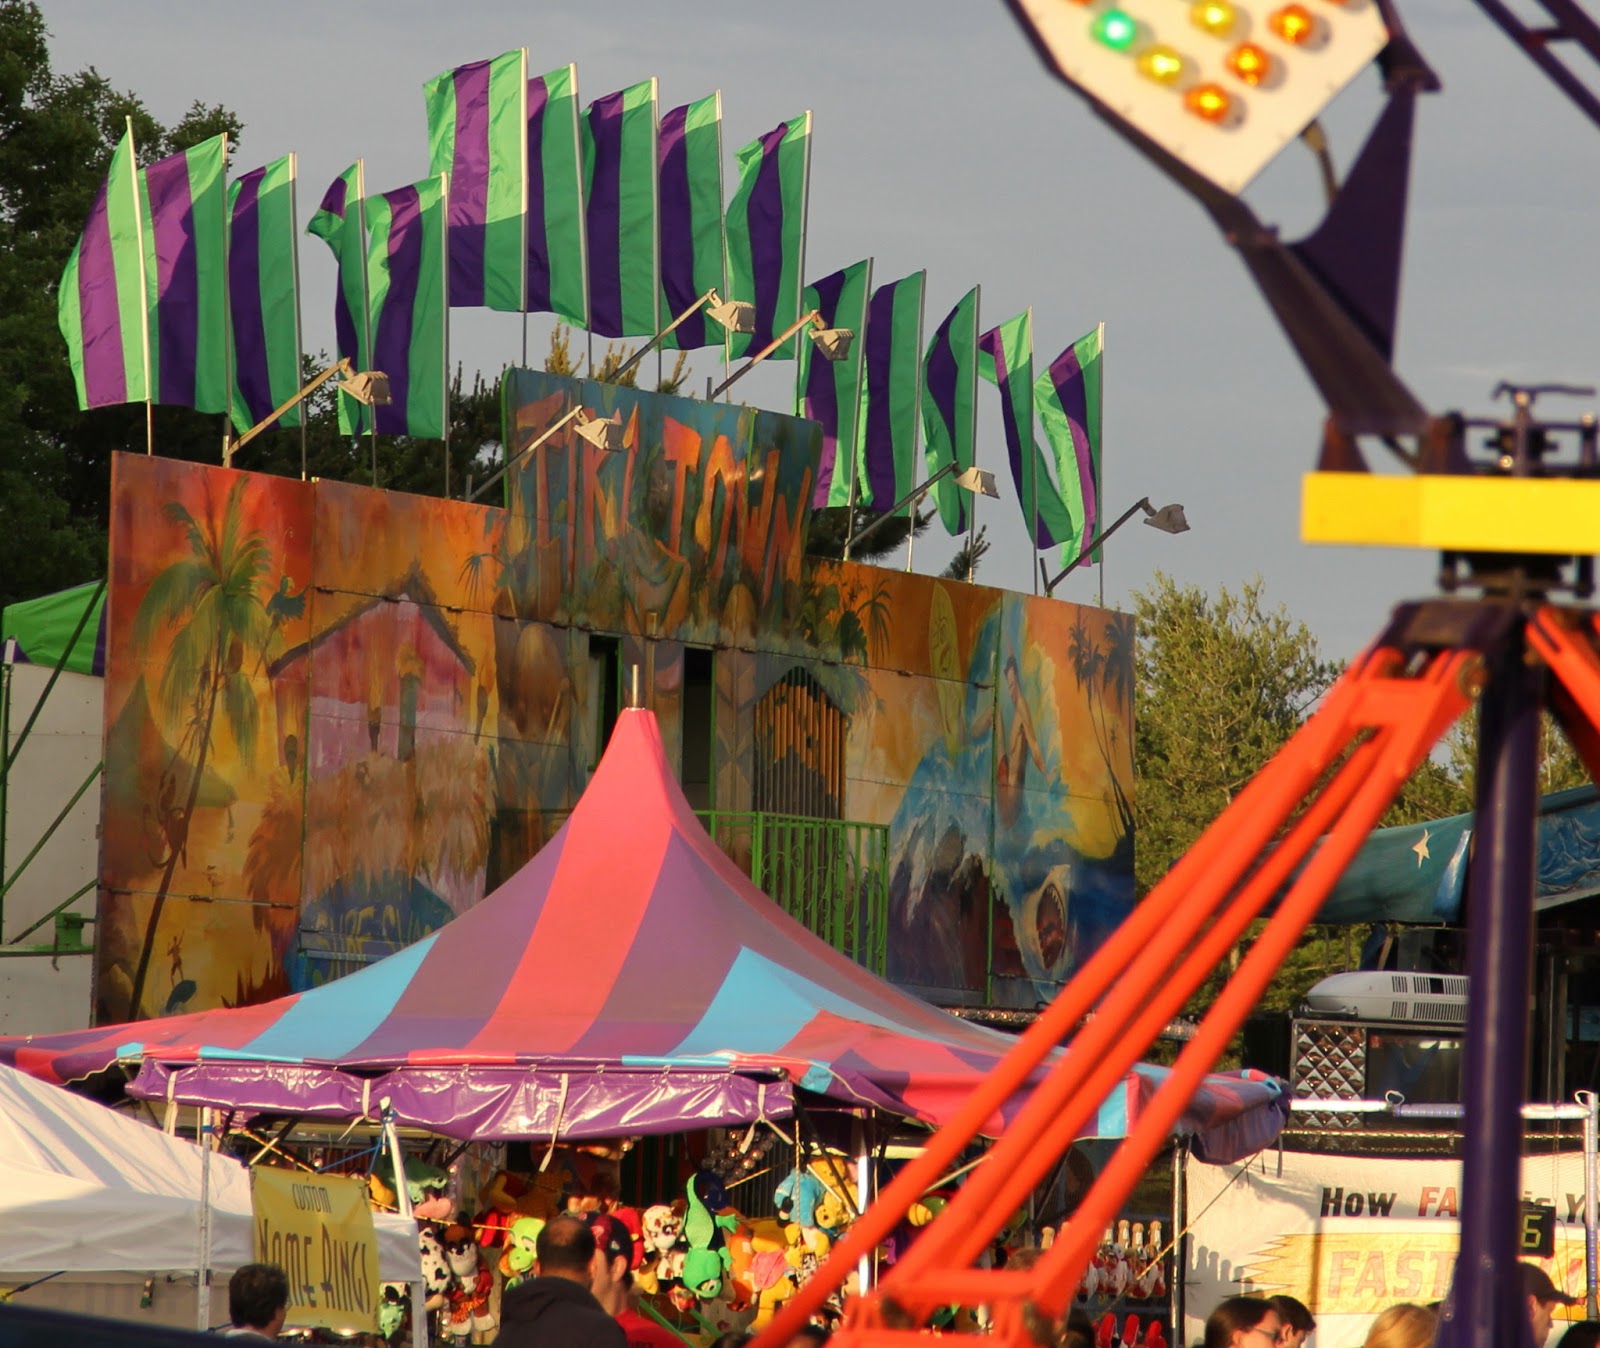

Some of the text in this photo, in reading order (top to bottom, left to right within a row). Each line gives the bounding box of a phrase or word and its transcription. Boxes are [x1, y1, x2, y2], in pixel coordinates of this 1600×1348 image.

[516, 389, 812, 607] TIKI TOWN
[292, 1183, 332, 1213] CUSTOM
[1418, 1186, 1458, 1217] FA
[321, 1222, 370, 1314] RINGS
